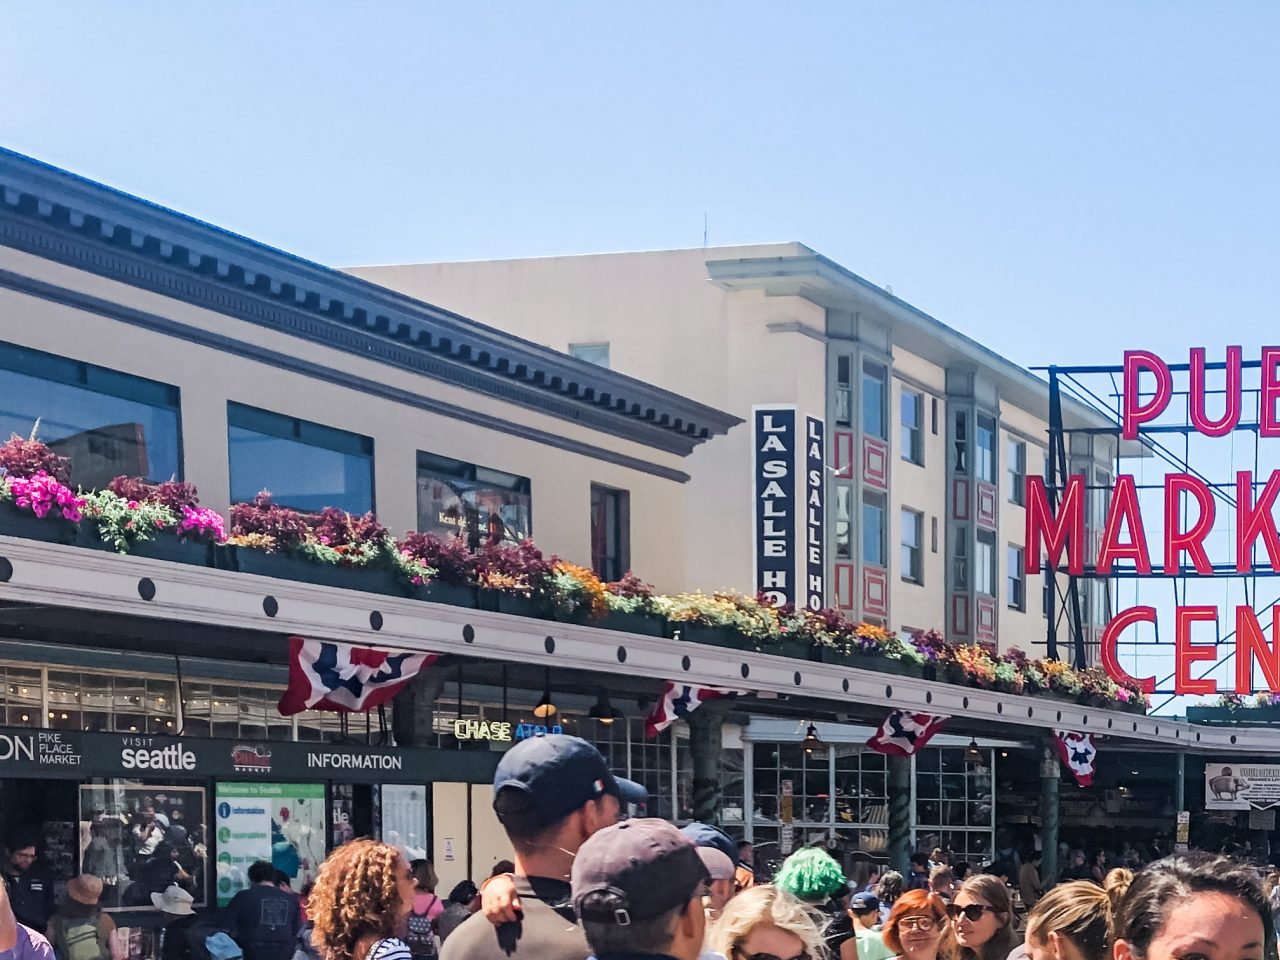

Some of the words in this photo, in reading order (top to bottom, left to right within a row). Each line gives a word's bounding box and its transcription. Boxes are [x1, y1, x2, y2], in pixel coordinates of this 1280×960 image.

[760, 415, 788, 452] LA
[808, 421, 821, 460] LA
[760, 459, 788, 557] SALLE
[808, 470, 821, 565] SALLE
[38, 733, 62, 743] PIKE
[454, 719, 512, 741] CHASE
[39, 743, 74, 754] PLACE
[121, 737, 153, 746] VISIT
[39, 755, 82, 765] MARKET
[121, 743, 196, 770] seattle
[307, 753, 402, 769] INFORMATION
